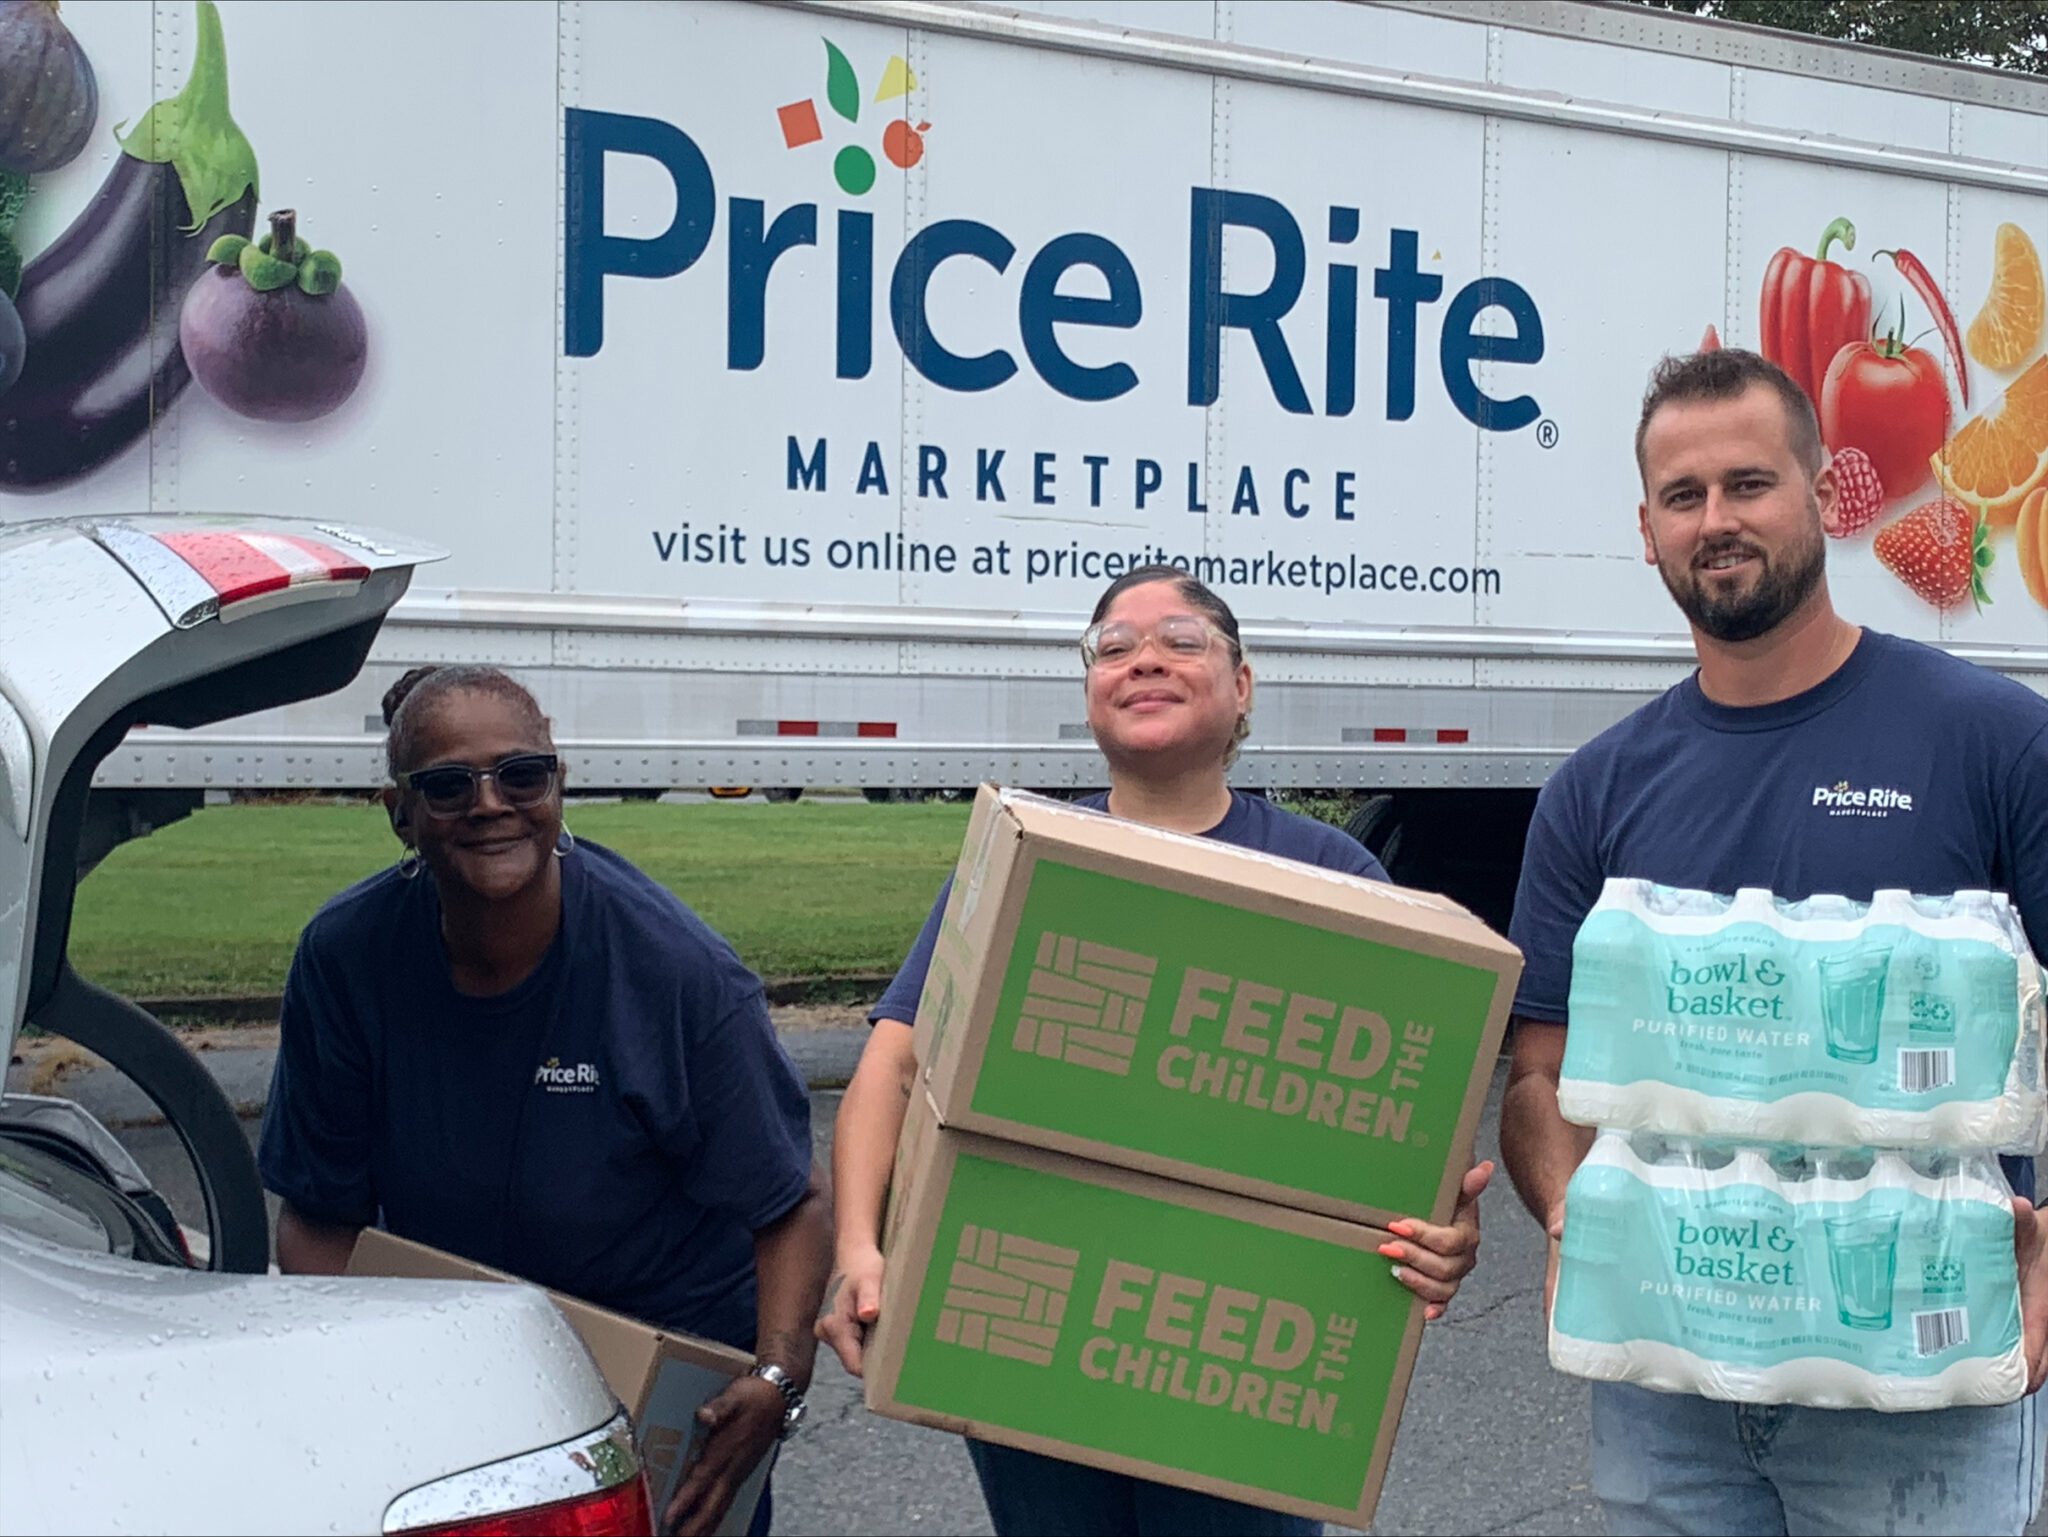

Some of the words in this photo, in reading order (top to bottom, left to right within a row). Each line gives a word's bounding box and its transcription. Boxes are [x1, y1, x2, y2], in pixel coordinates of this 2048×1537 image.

[564, 107, 1142, 401] Price
[786, 435, 1357, 521] MARKETPLACE
[652, 523, 746, 566] visit
[764, 536, 811, 567] us
[827, 532, 957, 574] online
[972, 539, 1011, 576] at
[1812, 787, 1866, 806] Price
[1867, 788, 1912, 811] Rite
[1670, 953, 1748, 985] bowl
[1755, 959, 1785, 986] &
[1169, 966, 1392, 1080] FEED
[1666, 986, 1784, 1020] basket
[1632, 1018, 1728, 1042] PURIFIED
[1736, 1027, 1811, 1047] WATER
[1389, 1020, 1435, 1092] THE
[1677, 1217, 1760, 1250] bowl
[1767, 1225, 1796, 1253] &
[1674, 1247, 1794, 1286] basket
[1092, 1259, 1317, 1372] FEED
[1640, 1280, 1738, 1307] PURIFIED
[1749, 1294, 1822, 1313] WATER
[1315, 1312, 1359, 1382] THE
